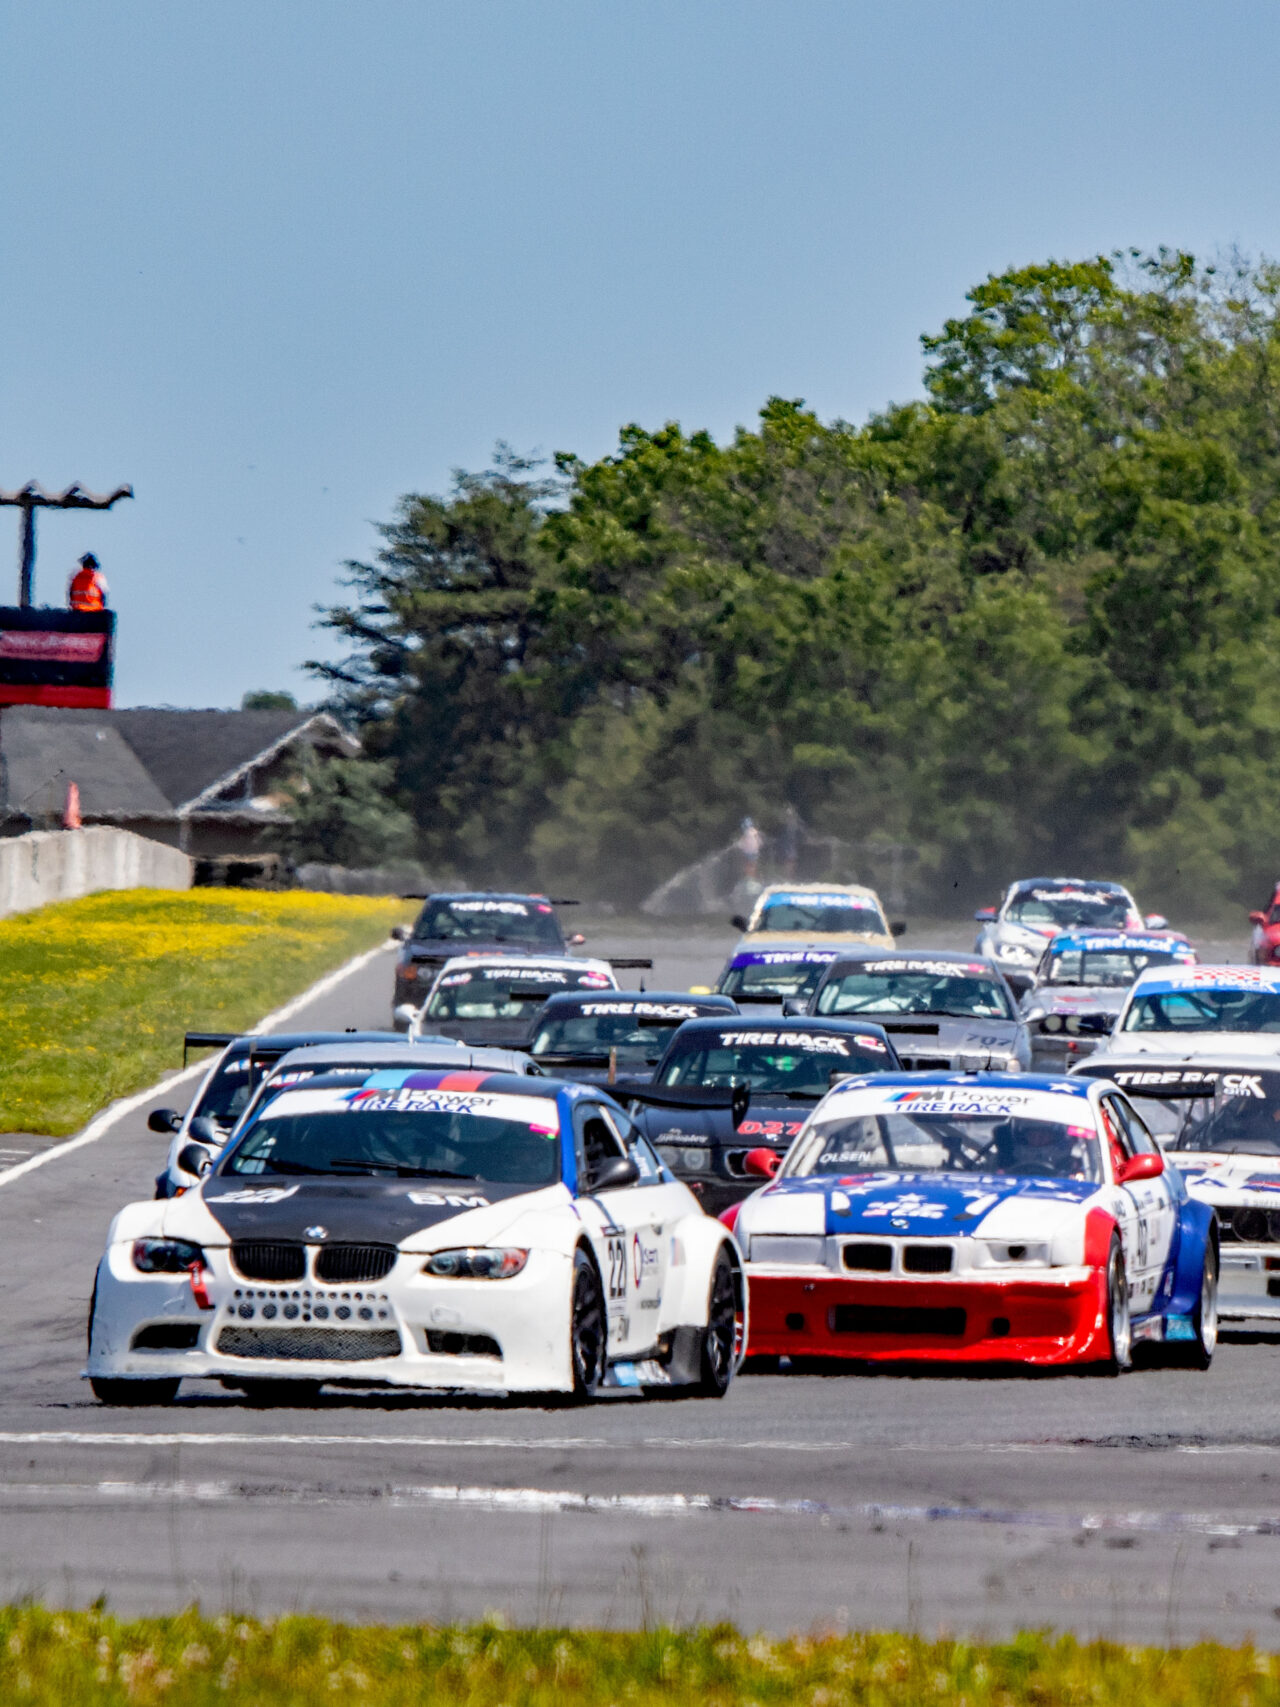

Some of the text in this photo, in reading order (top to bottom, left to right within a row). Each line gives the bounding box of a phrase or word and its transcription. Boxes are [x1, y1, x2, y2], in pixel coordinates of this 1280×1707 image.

[581, 1003, 699, 1018] TIRE RACK
[720, 1032, 850, 1057] TIRE RACK
[949, 1090, 1034, 1105] Power
[347, 1099, 473, 1114] TIRE RACK
[895, 1102, 1013, 1113] TIRE RACK
[819, 1151, 870, 1164] OLSEN
